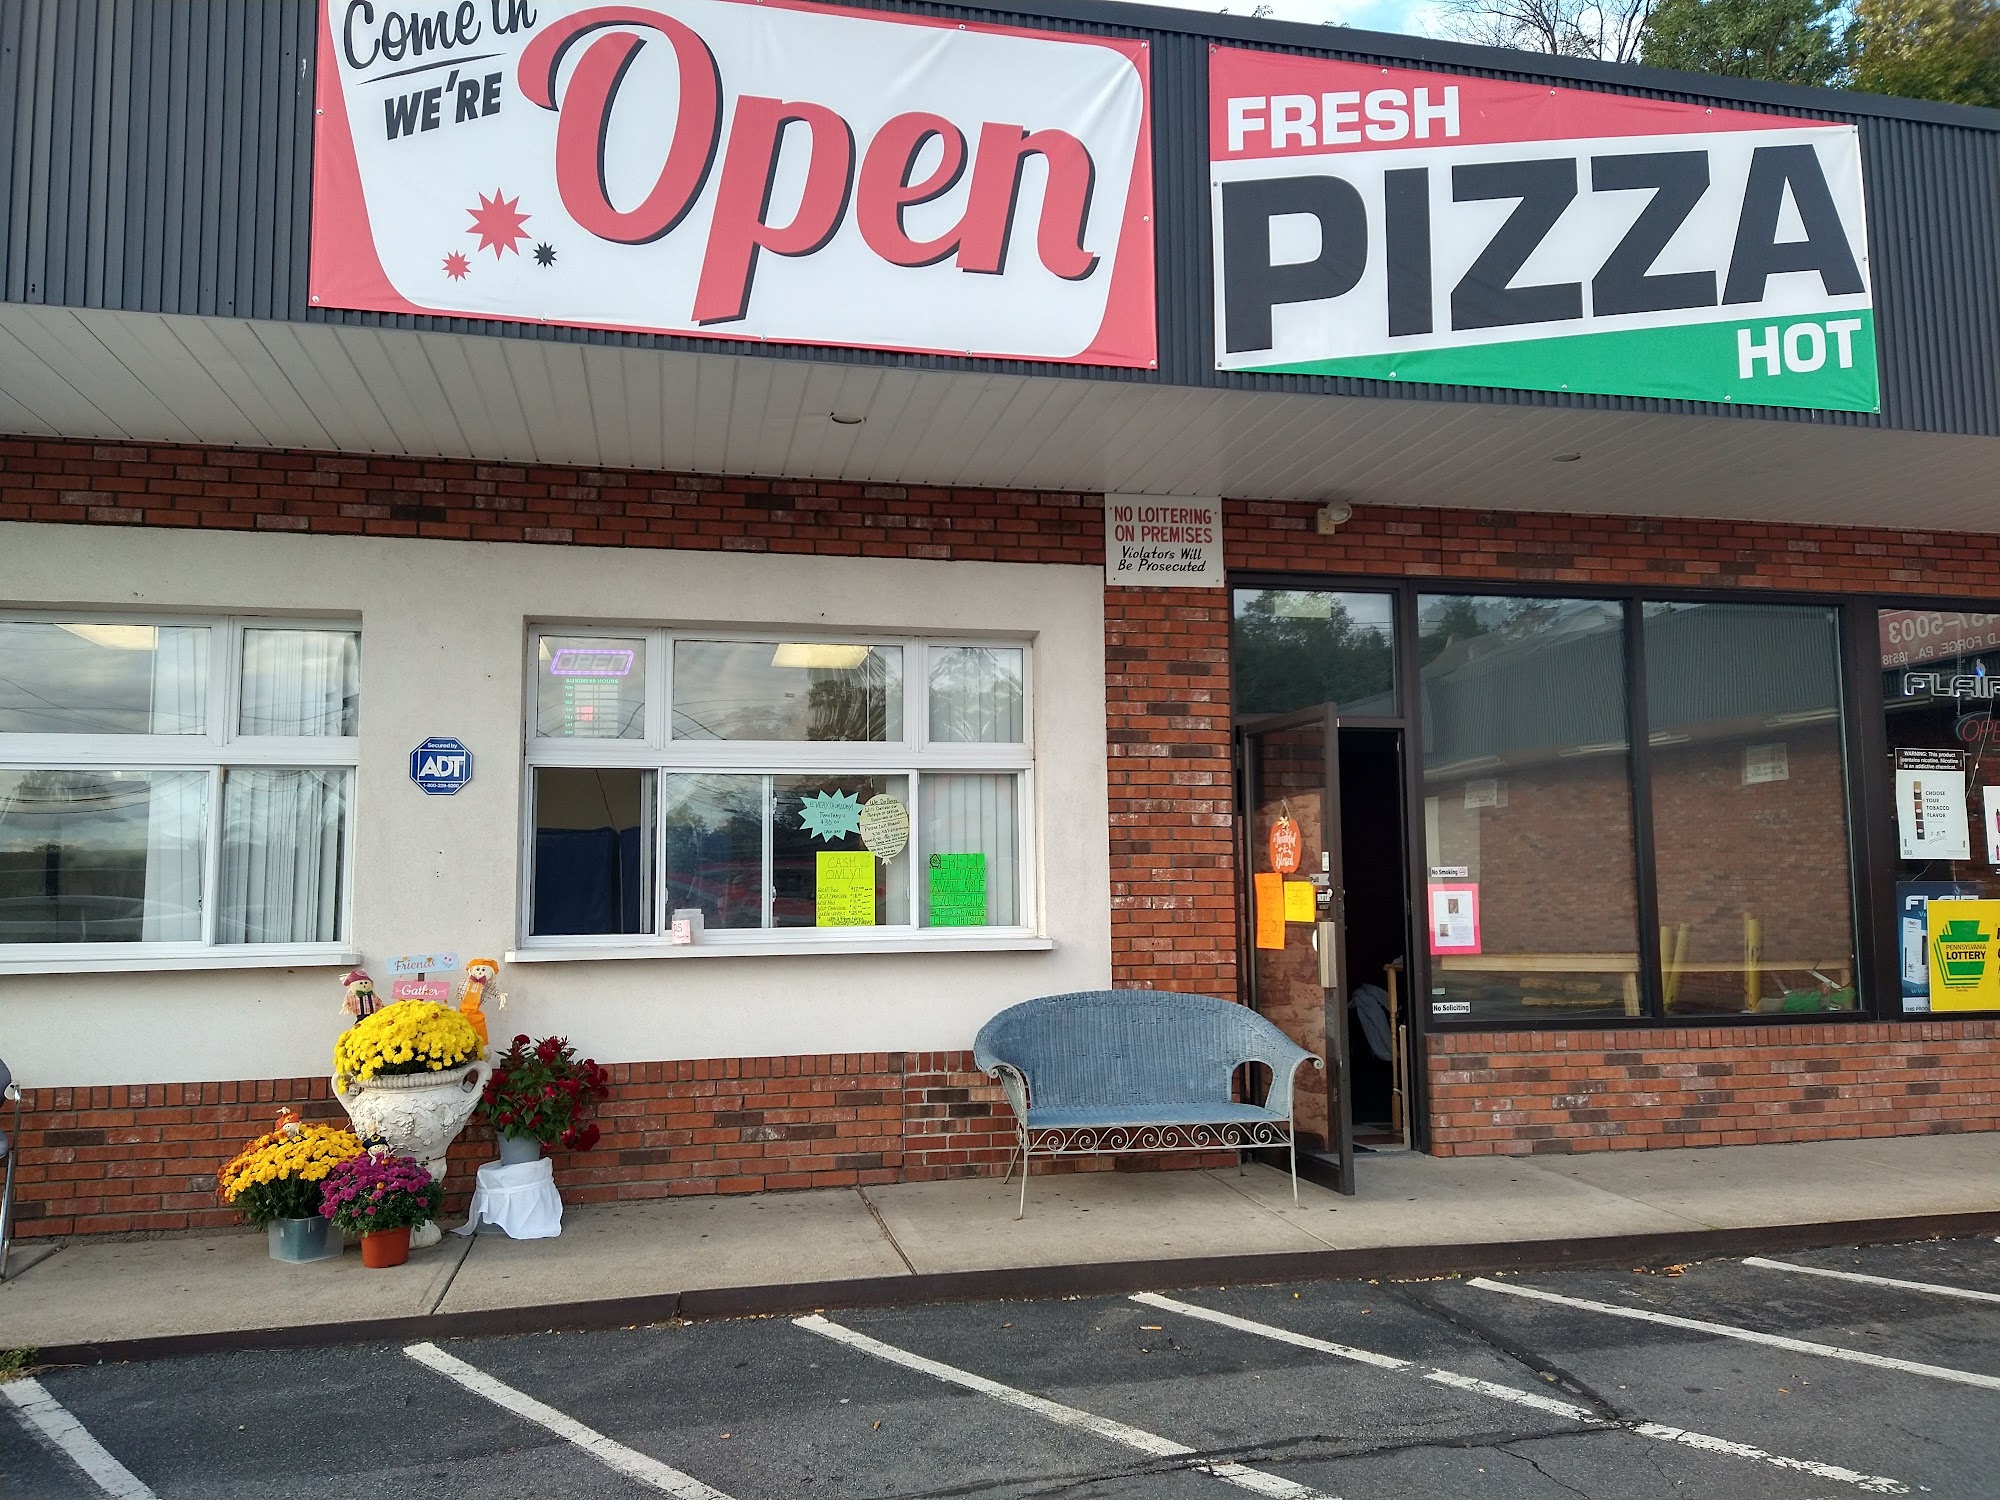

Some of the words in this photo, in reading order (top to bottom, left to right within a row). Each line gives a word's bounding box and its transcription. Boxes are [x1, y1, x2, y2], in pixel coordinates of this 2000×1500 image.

[343, 0, 481, 69] Come
[384, 69, 503, 141] WE'RE
[1227, 84, 1461, 152] FRESH
[517, 5, 1100, 326] Open
[1221, 143, 1866, 354] PIZZA
[1736, 318, 1862, 380] HOT
[1114, 506, 1133, 522] NO
[1138, 507, 1212, 524] LOITERING
[1114, 525, 1135, 542] ON
[1141, 525, 1213, 543] PREMISES
[1122, 545, 1175, 559] Violators
[1180, 548, 1202, 560] Will
[1117, 559, 1133, 571] Be
[1137, 558, 1206, 572] Prosecuted
[556, 654, 628, 670] OPEN
[419, 755, 465, 777] ADT
[828, 856, 856, 868] CASH
[394, 958, 436, 971] Friends
[1946, 951, 1987, 960] LOTTERY
[401, 984, 439, 996] Gather
[1442, 1004, 1469, 1012] Soliciting
